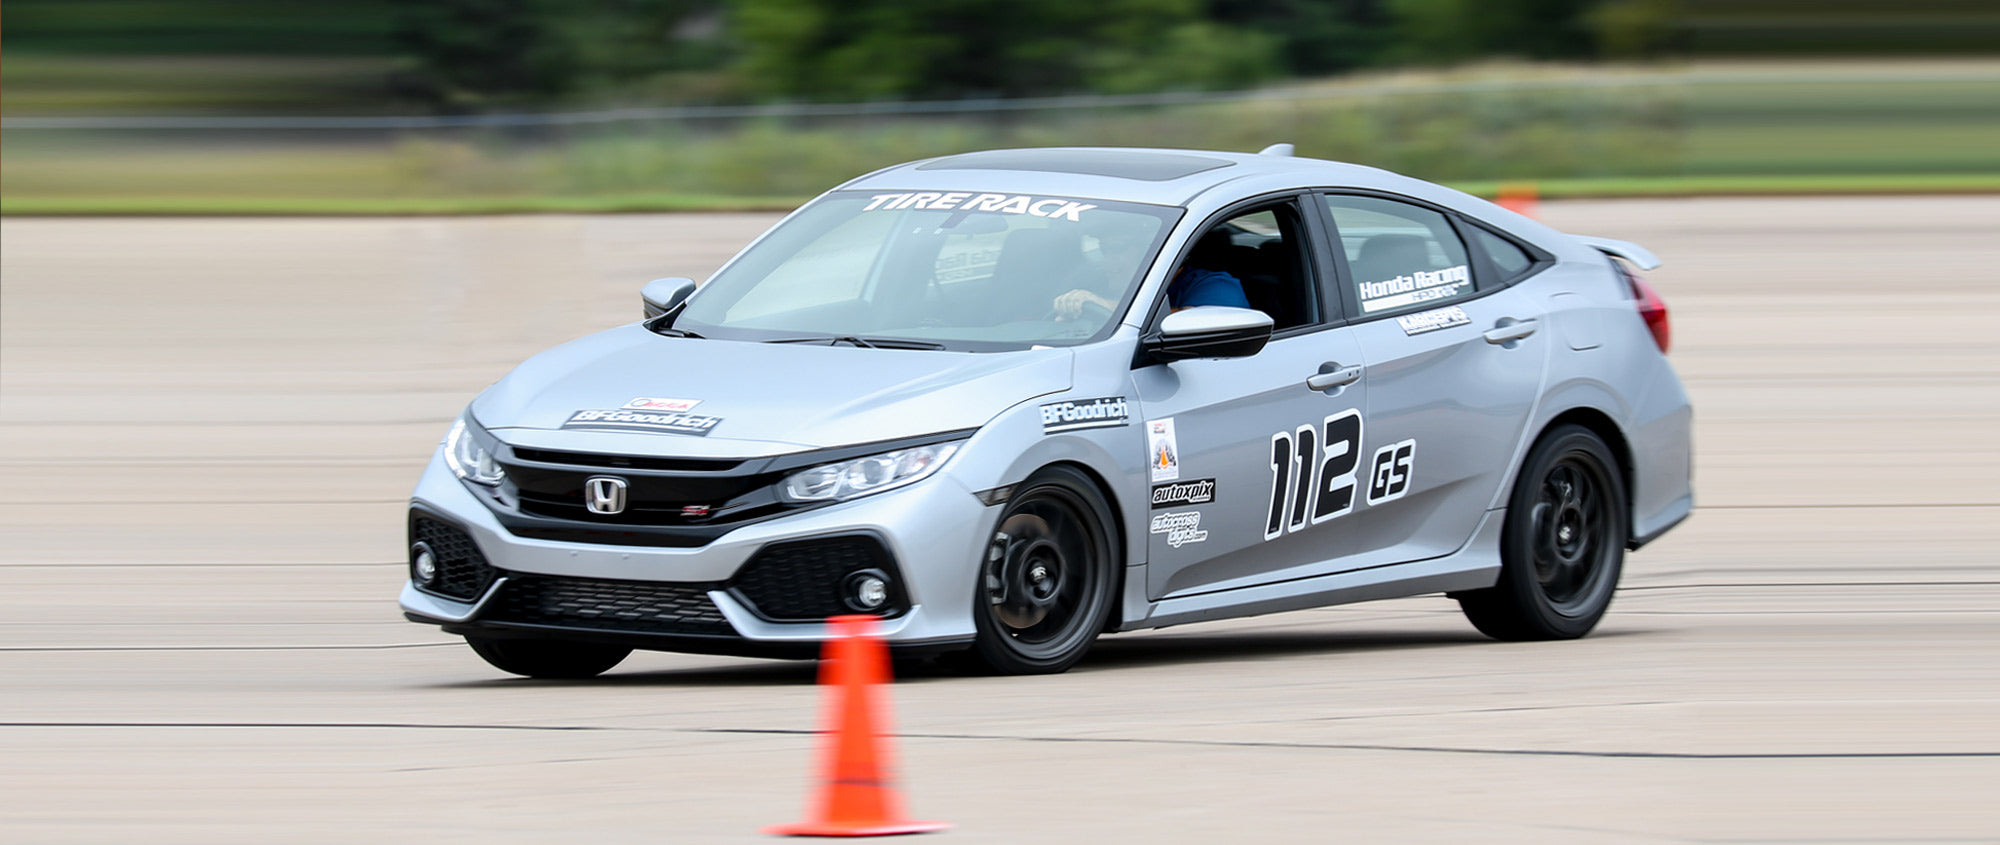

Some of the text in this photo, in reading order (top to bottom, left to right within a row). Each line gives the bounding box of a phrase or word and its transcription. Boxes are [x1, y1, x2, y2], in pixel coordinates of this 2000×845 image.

[862, 192, 1098, 222] TIRE RACK
[1359, 275, 1415, 300] Honda
[1413, 265, 1470, 289] Racing
[570, 410, 718, 429] BFGoodrich
[1039, 397, 1129, 424] BFGoodrich
[1265, 408, 1416, 541] 112 GS
[1152, 480, 1214, 503] autoxpix
[1151, 511, 1200, 533] autocross
